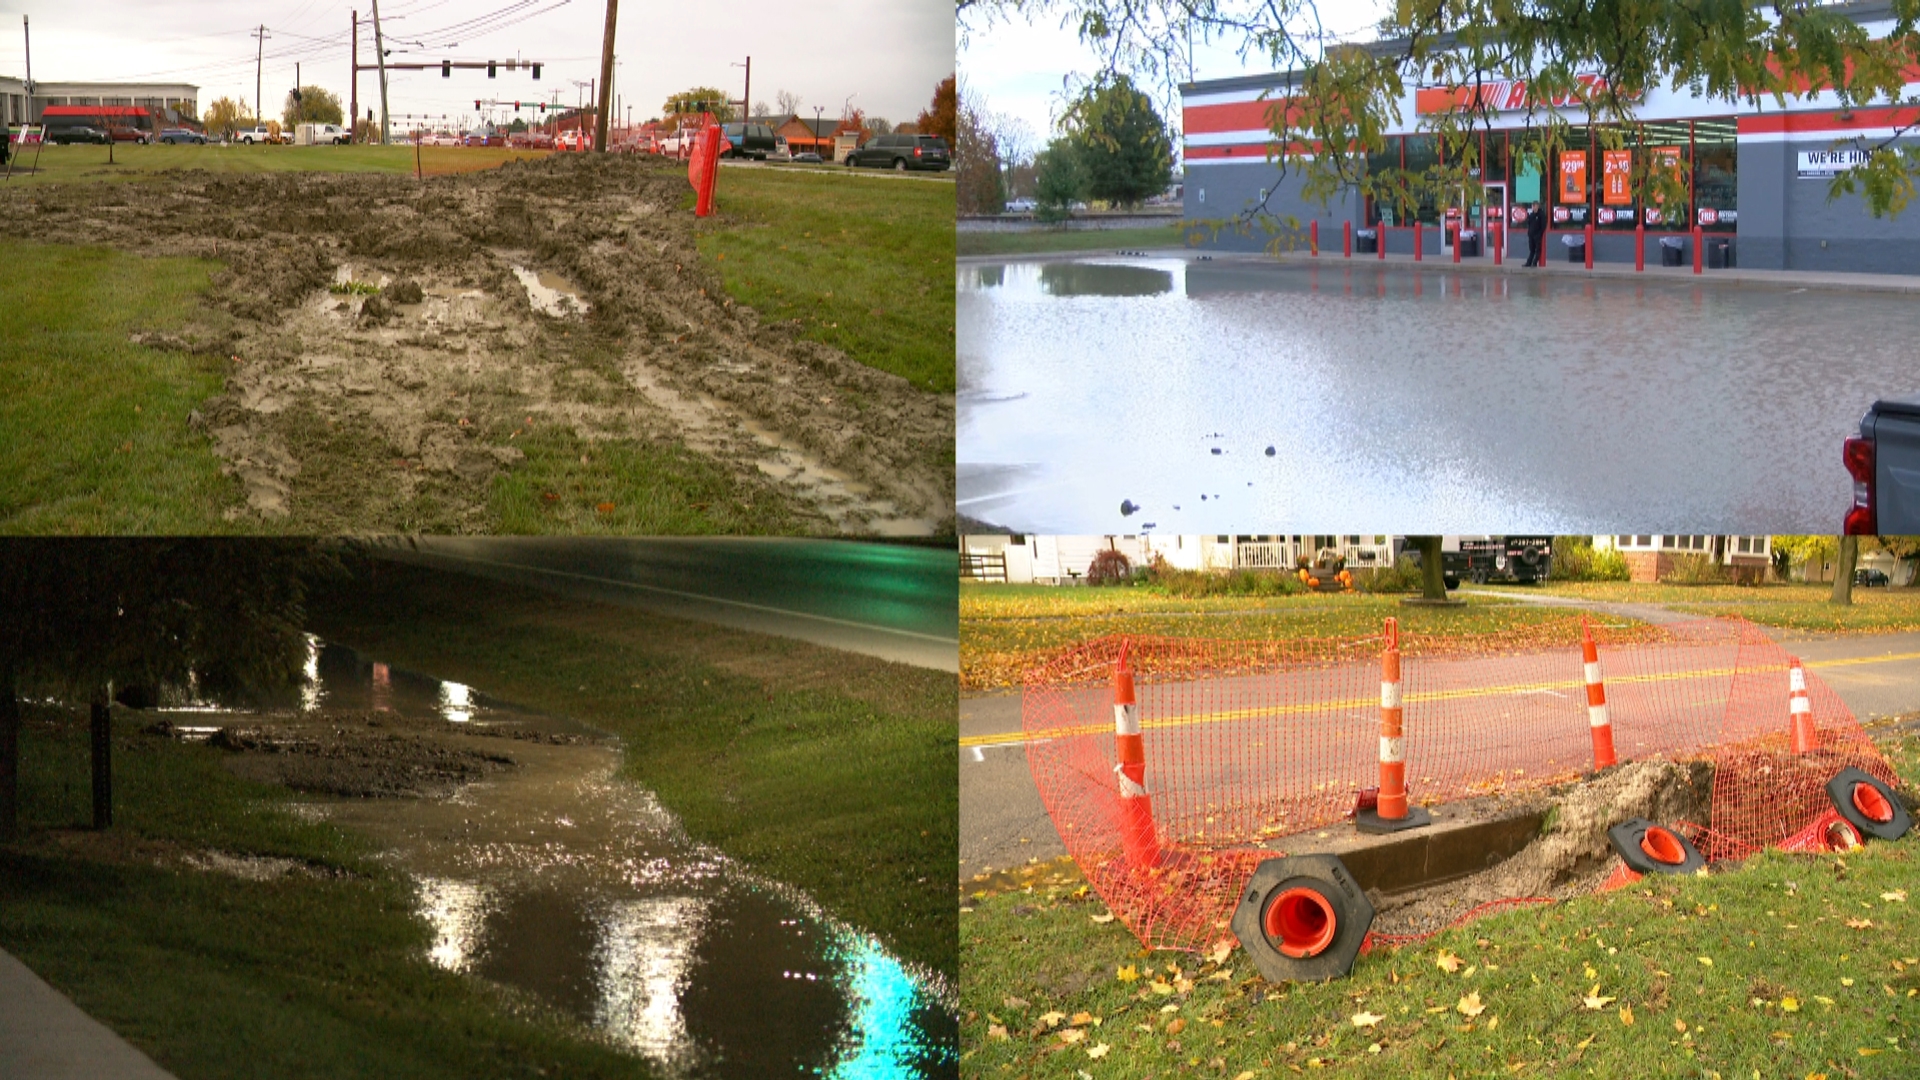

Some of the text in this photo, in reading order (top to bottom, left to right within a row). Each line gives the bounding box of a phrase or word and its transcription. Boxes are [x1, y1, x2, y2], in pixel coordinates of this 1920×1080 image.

[1808, 151, 1845, 164] WE'RE
[1556, 209, 1568, 220] FREE
[1601, 210, 1613, 220] FREE
[1700, 211, 1715, 222] FREE
